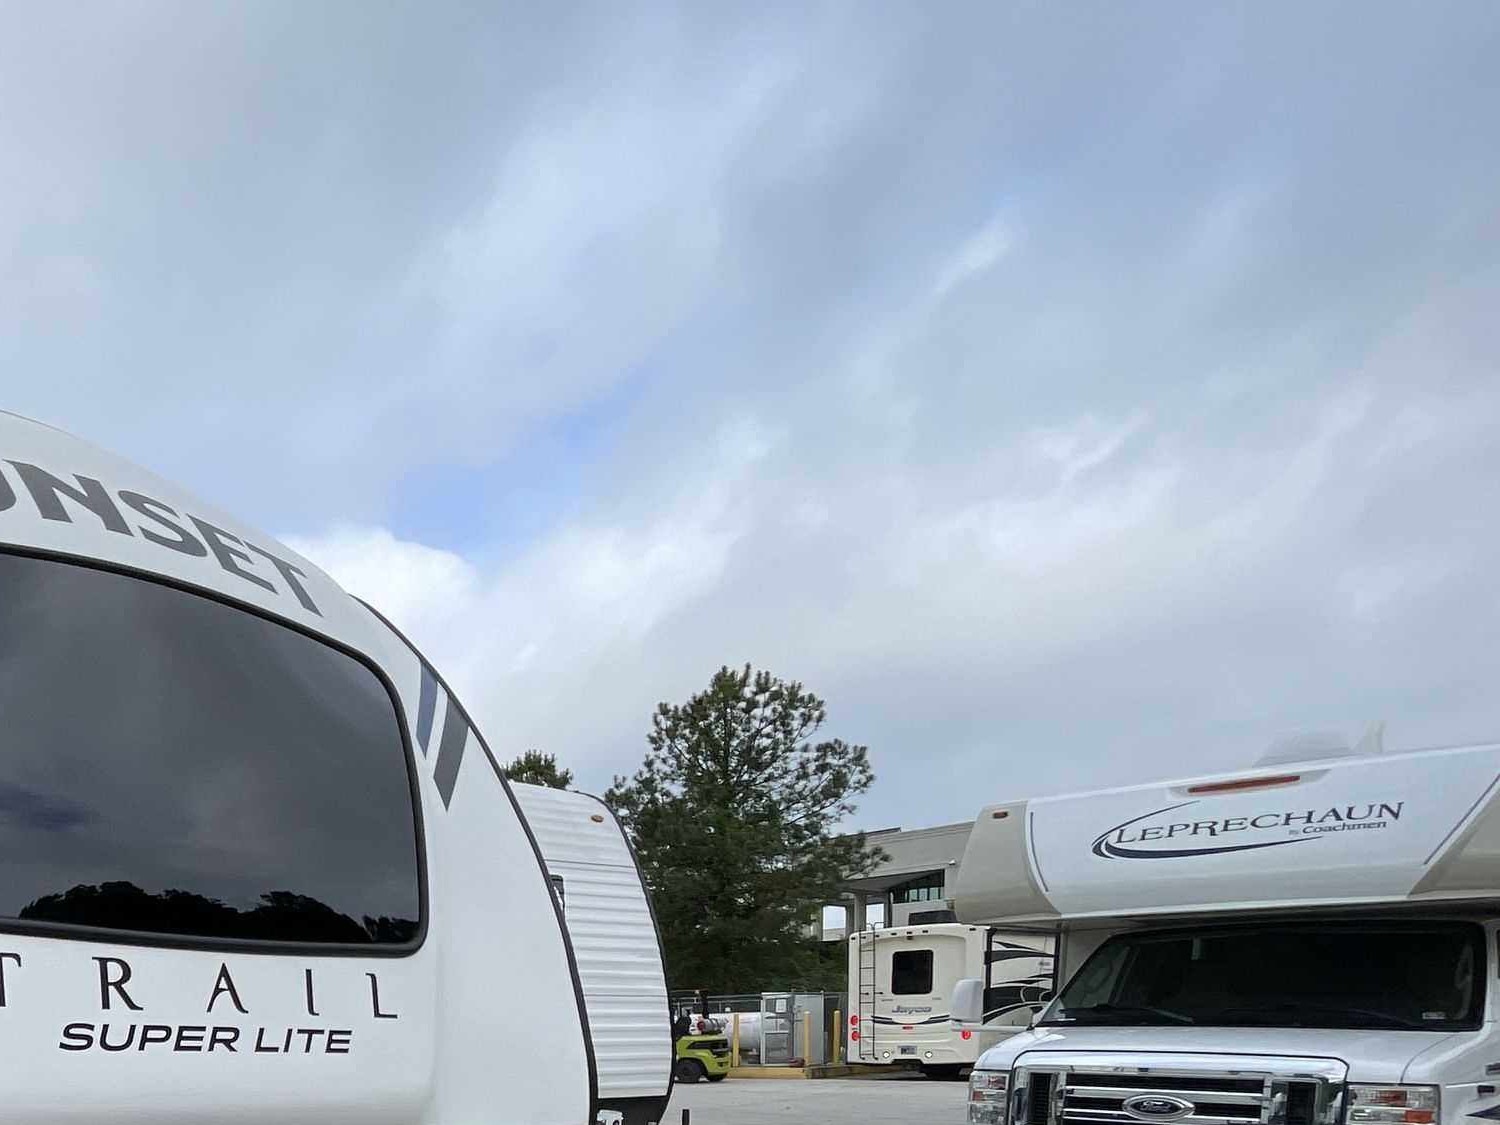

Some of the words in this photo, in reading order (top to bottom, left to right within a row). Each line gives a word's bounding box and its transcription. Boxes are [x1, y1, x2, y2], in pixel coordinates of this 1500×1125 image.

[1115, 802, 1404, 844] LEPRECHAUN
[1302, 821, 1387, 834] Coachmen
[892, 1005, 932, 1014] Jayco
[59, 1023, 240, 1053] SUPER
[254, 1027, 353, 1054] LITE
